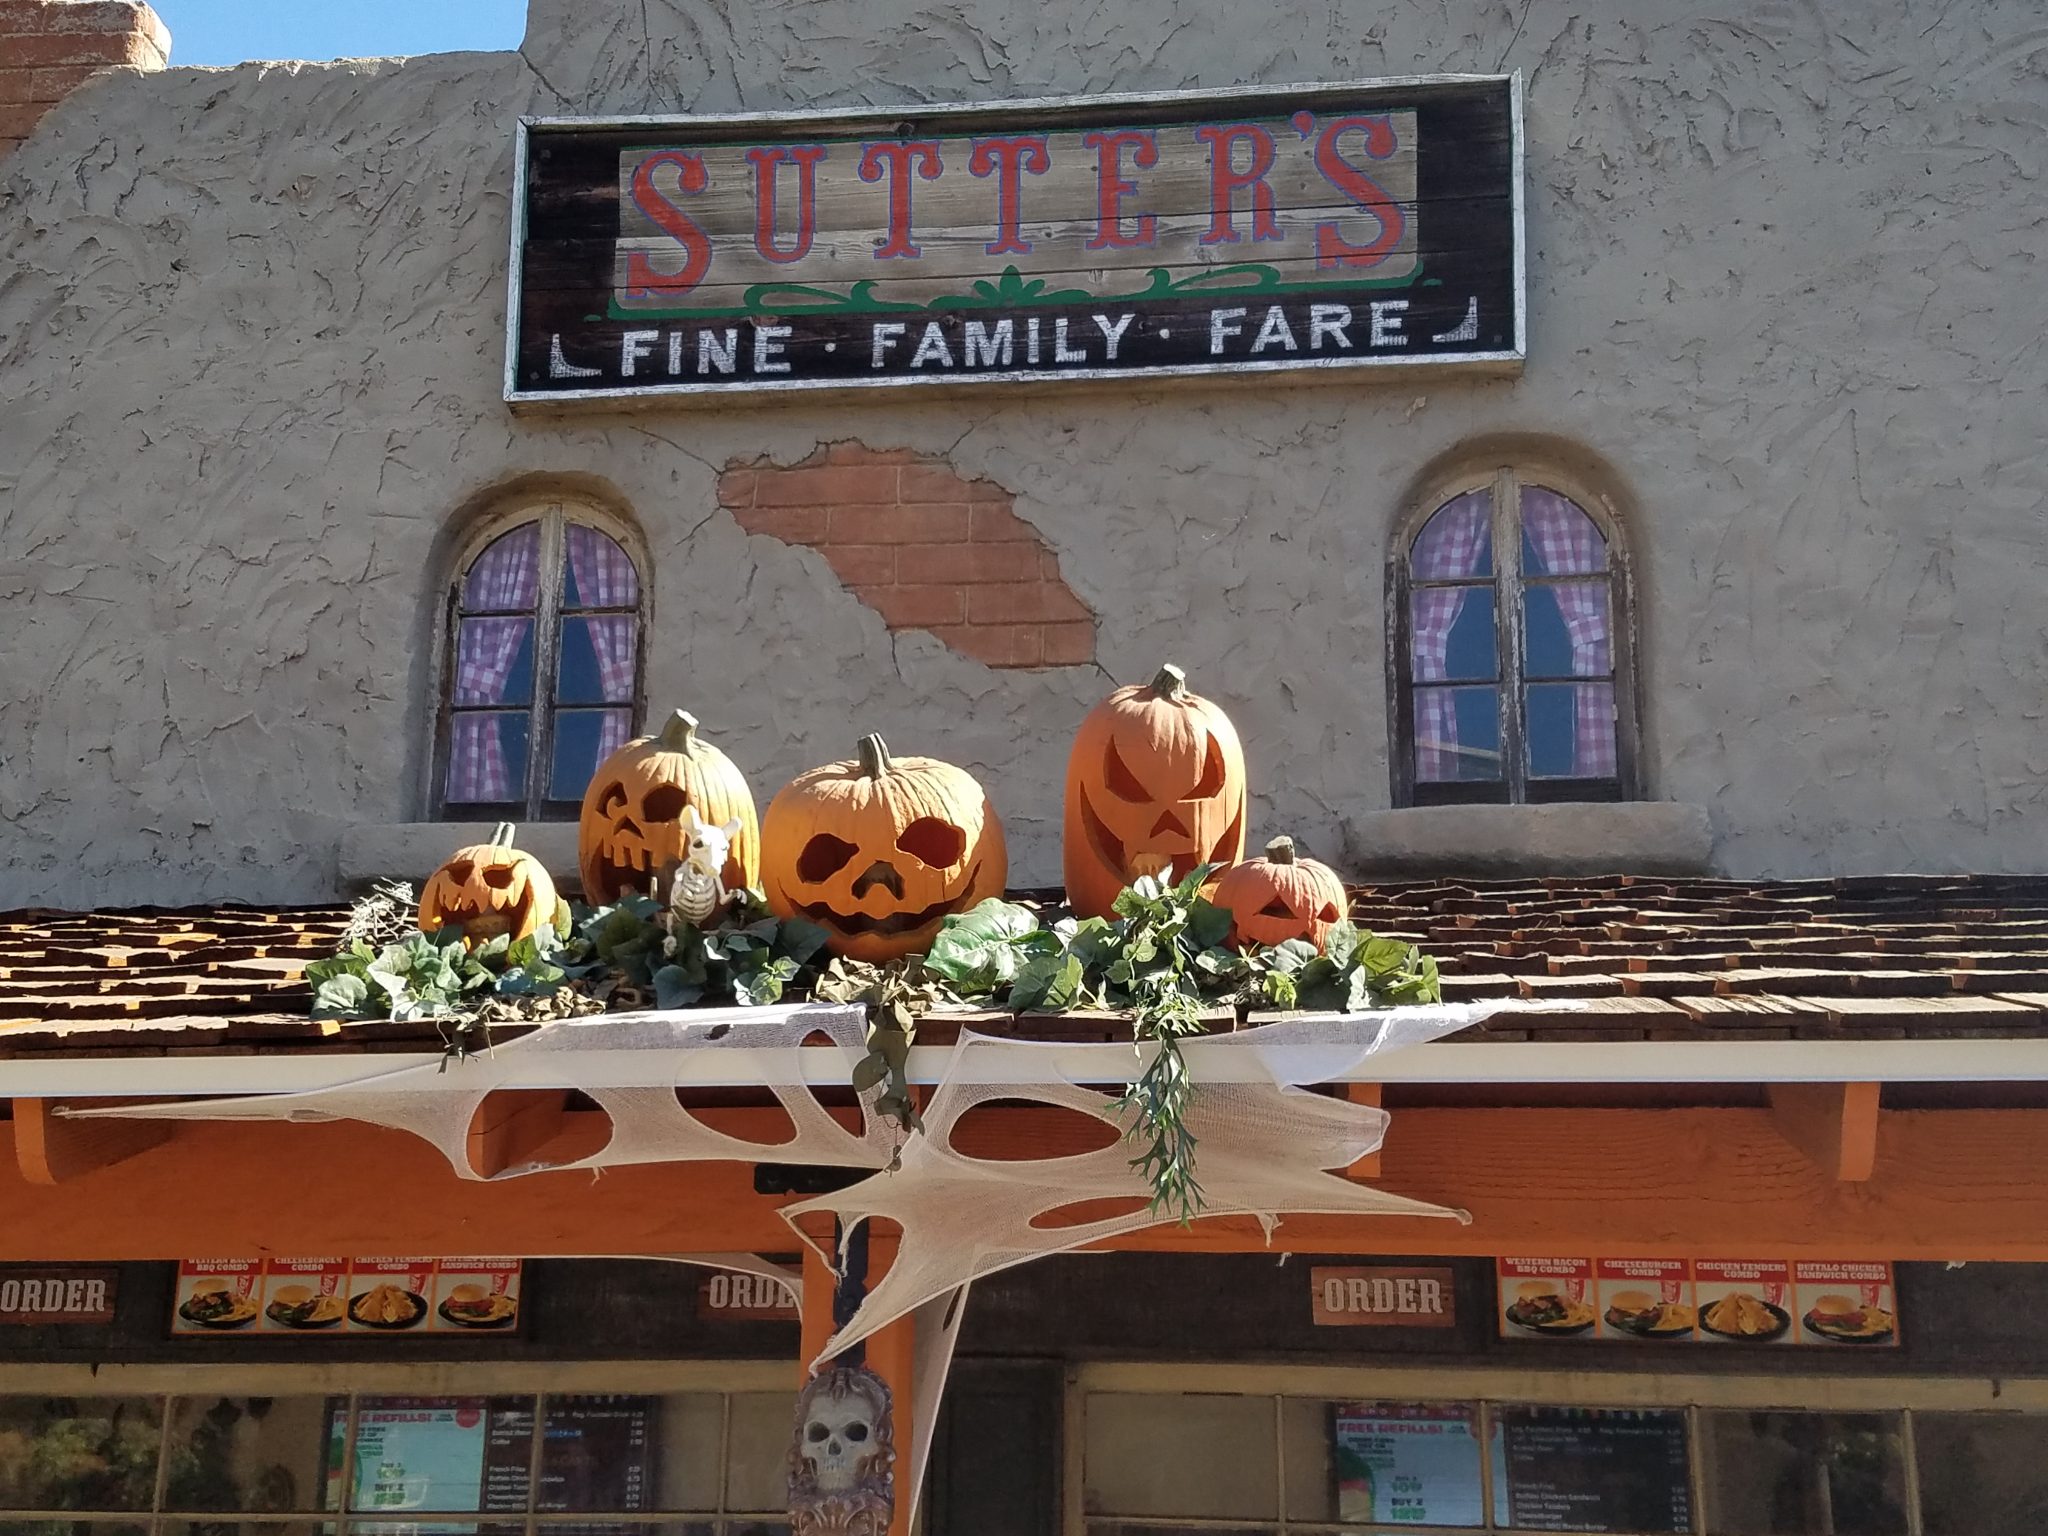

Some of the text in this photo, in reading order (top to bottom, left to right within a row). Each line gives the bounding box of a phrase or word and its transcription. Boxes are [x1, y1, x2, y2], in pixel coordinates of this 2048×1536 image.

[624, 110, 1407, 300] SUTTER'S
[621, 300, 1410, 377] FINE FAMILY FARE
[1506, 1258, 1587, 1267] WESTERN BACON
[1604, 1260, 1682, 1269] CHEESEBURGER
[1696, 1262, 1787, 1272] CHICKEN TENDERS
[1841, 1263, 1885, 1272] CHICKEN
[1517, 1266, 1576, 1274] BBQ COMBO
[1624, 1268, 1661, 1276] COMBO
[1797, 1271, 1886, 1280] SANDWICH COMBO
[0, 1279, 105, 1312] ORDER
[709, 1275, 797, 1309] ORDE
[1324, 1278, 1443, 1314] ORDER
[334, 1413, 371, 1423] FE
